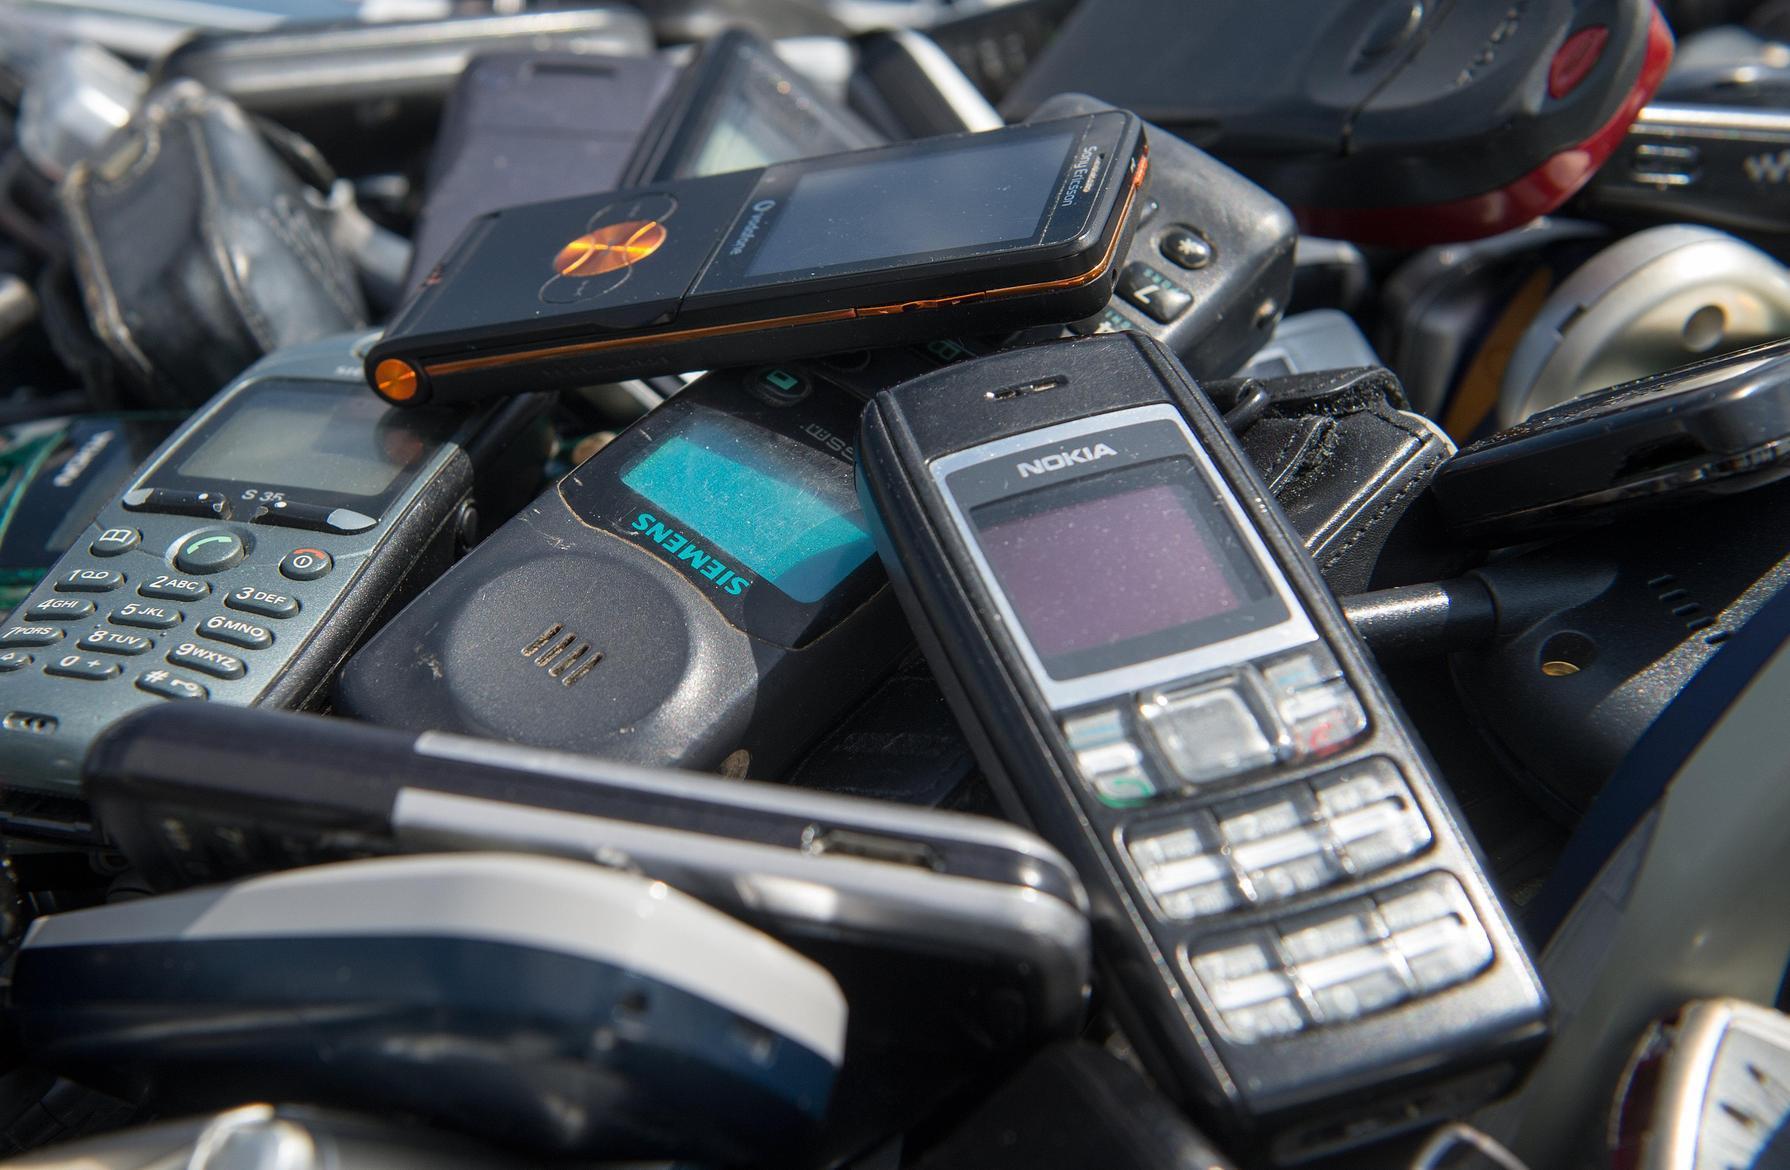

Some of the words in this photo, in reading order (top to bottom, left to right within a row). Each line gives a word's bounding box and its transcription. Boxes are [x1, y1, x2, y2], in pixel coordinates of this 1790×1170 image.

[1074, 145, 1098, 169] Sony
[1061, 168, 1088, 207] Ericsson
[730, 210, 764, 256] vodafone
[1133, 284, 1160, 304] 7
[1016, 442, 1118, 478] NOKIA
[241, 489, 259, 500] S
[259, 491, 286, 501] 35
[631, 513, 750, 595] SIEMENS
[165, 578, 200, 591] ABC
[235, 586, 255, 600] 3
[253, 591, 287, 604] DEF
[121, 603, 141, 616] 5
[138, 606, 166, 618] JKL
[87, 630, 109, 643] 8
[108, 633, 142, 645] TUV
[223, 619, 265, 638] MNO
